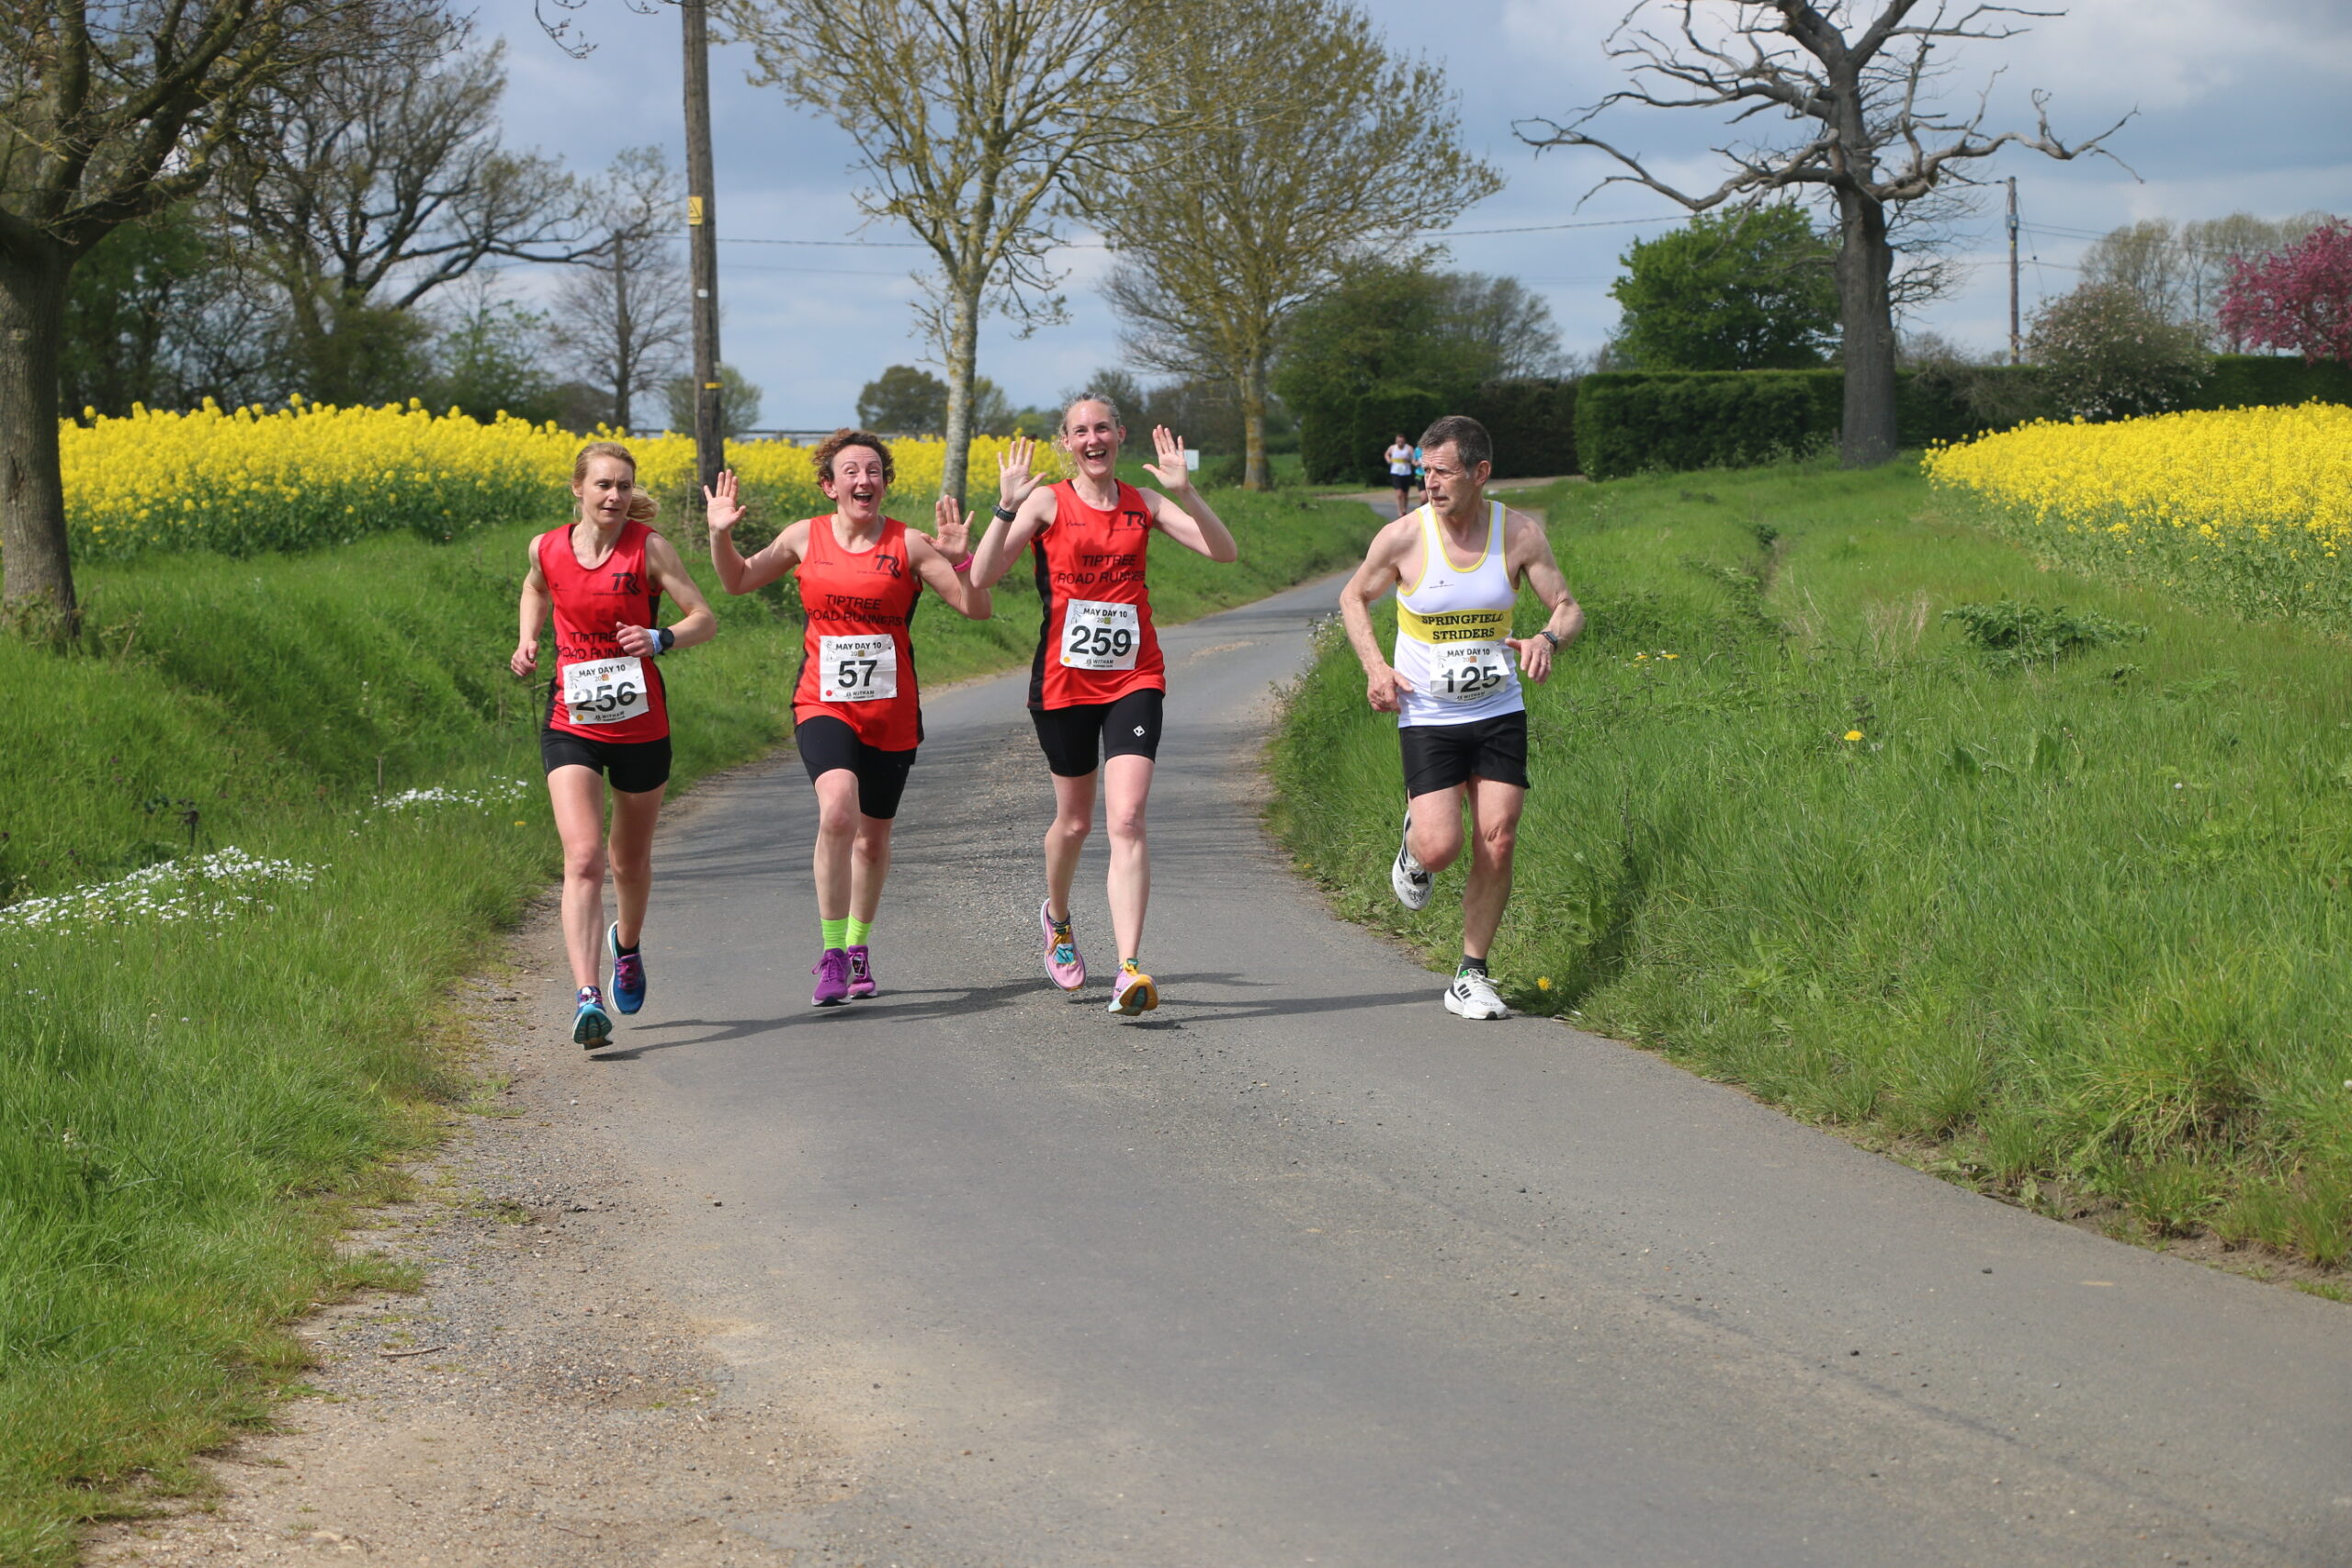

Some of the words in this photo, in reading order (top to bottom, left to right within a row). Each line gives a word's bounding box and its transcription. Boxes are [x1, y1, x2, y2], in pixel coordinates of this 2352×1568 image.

[1082, 554, 1136, 567] TIPTREE
[1057, 572, 1095, 584] ROAD
[825, 594, 883, 610] TIPTREE
[843, 611, 904, 626] RUNNERS
[1084, 608, 1101, 616] MAY
[1102, 609, 1117, 617] DAY
[1421, 614, 1504, 626] SPRINGFIELD
[570, 630, 617, 644] TIPTRE
[1433, 627, 1495, 640] STRIDERS
[855, 642, 870, 650] DAY
[1069, 625, 1132, 657] 259
[579, 669, 596, 677] MAY
[598, 665, 614, 674] DAY
[838, 660, 877, 688] 57
[1442, 666, 1501, 693] 125
[573, 682, 638, 712] 256
